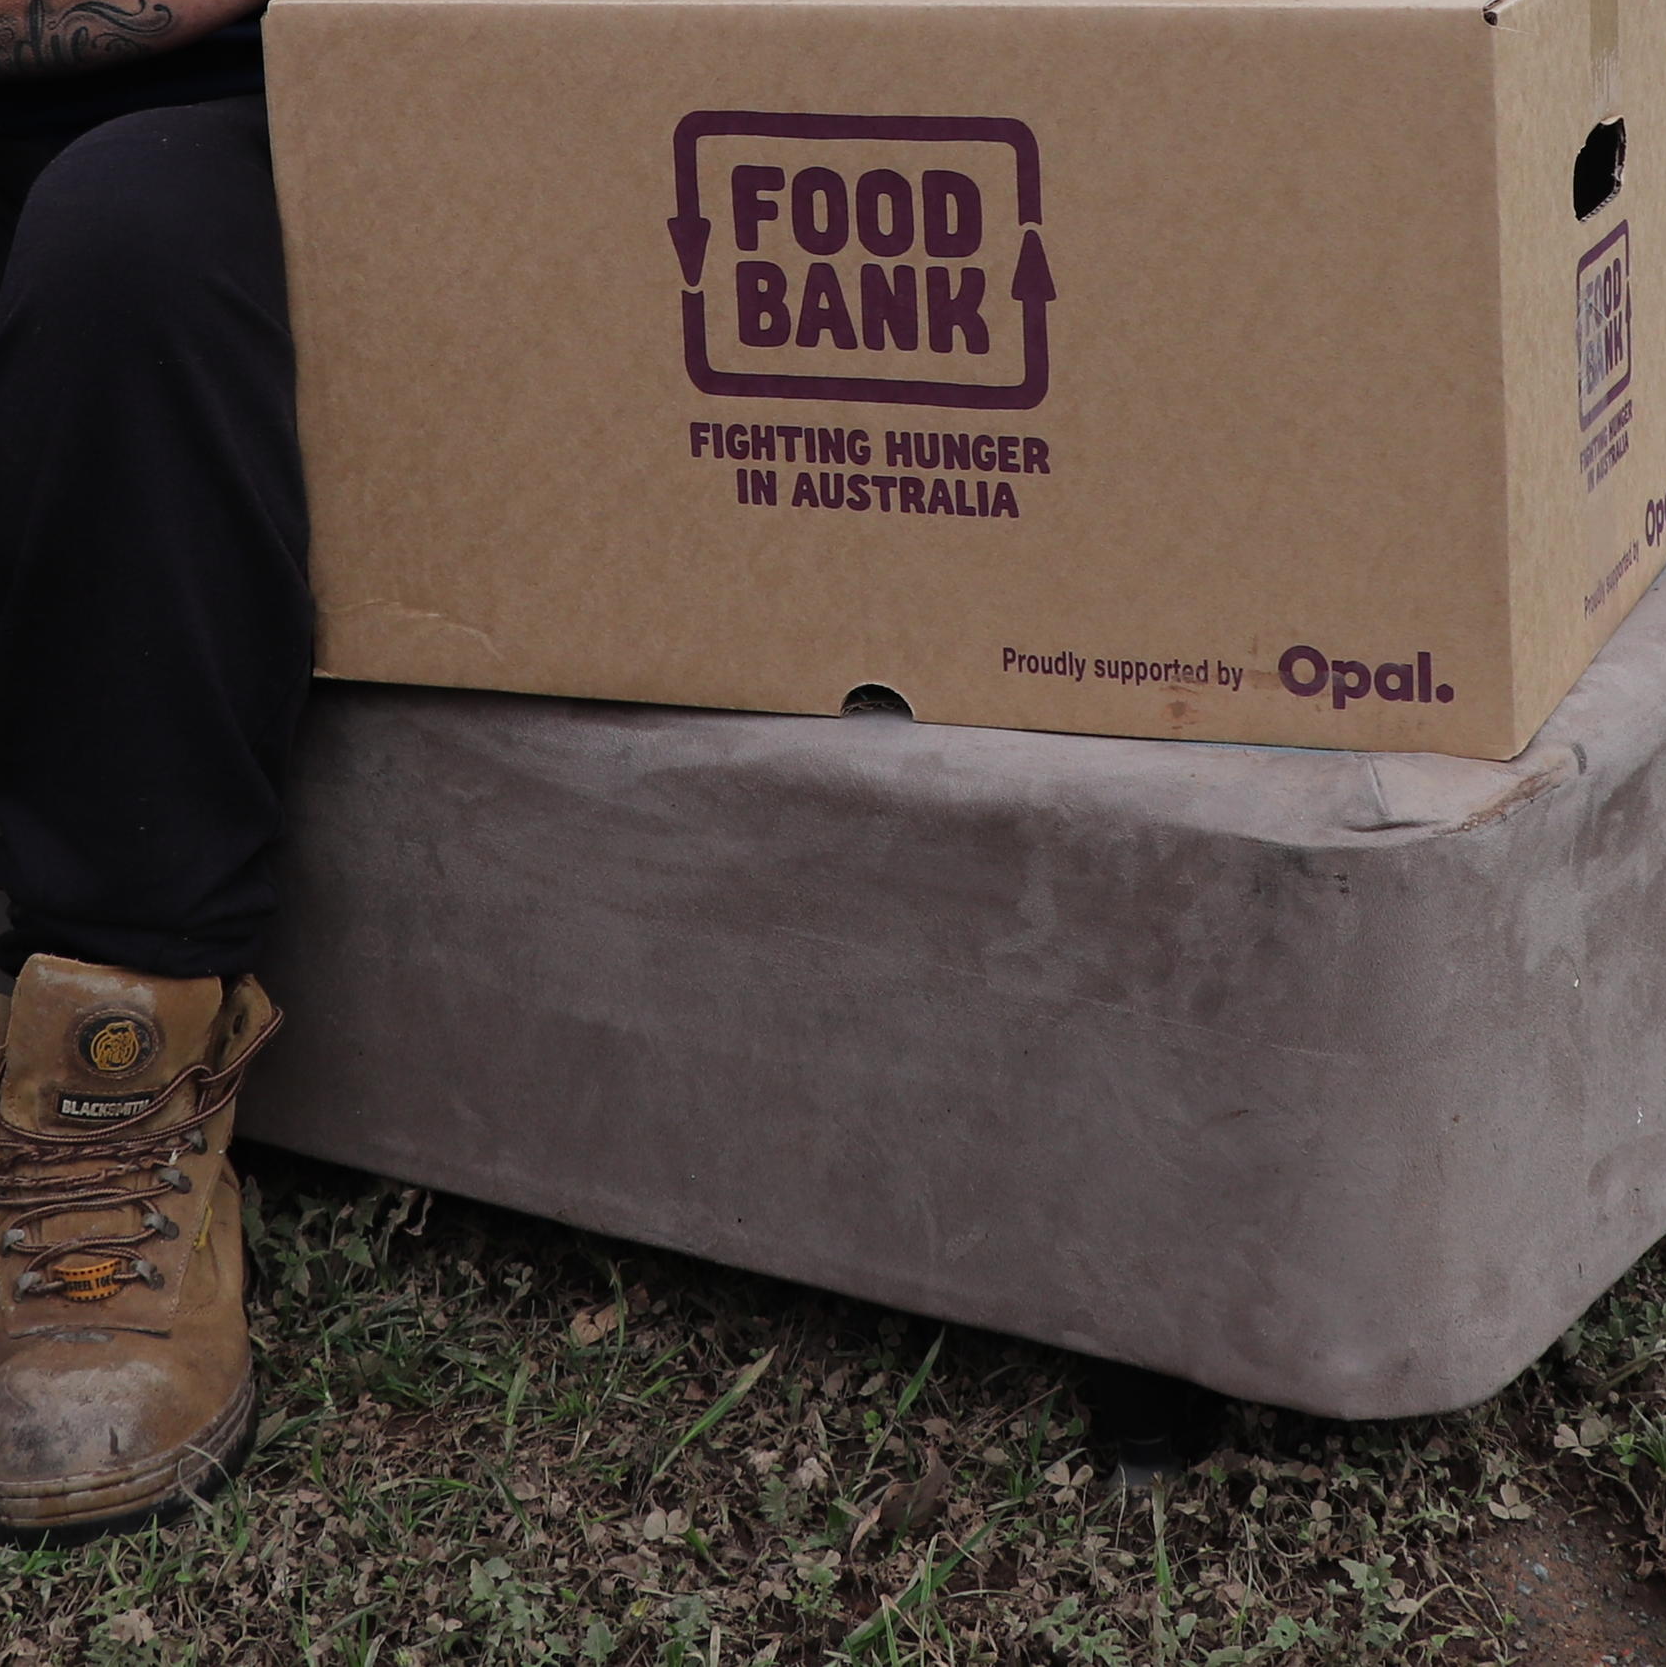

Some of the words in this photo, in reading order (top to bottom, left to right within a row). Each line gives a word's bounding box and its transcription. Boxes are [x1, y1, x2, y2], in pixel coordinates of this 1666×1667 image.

[731, 165, 982, 258] FOOD
[735, 260, 990, 355] BANK
[689, 421, 871, 466] FIGHTING
[885, 430, 1051, 474] HUNGER
[736, 468, 777, 506] IN
[791, 472, 1019, 518] AUSTRALIA
[1001, 646, 1086, 682] Proudly
[1093, 658, 1209, 686] supported
[1218, 661, 1244, 692] by
[1278, 644, 1454, 709] Opal.
